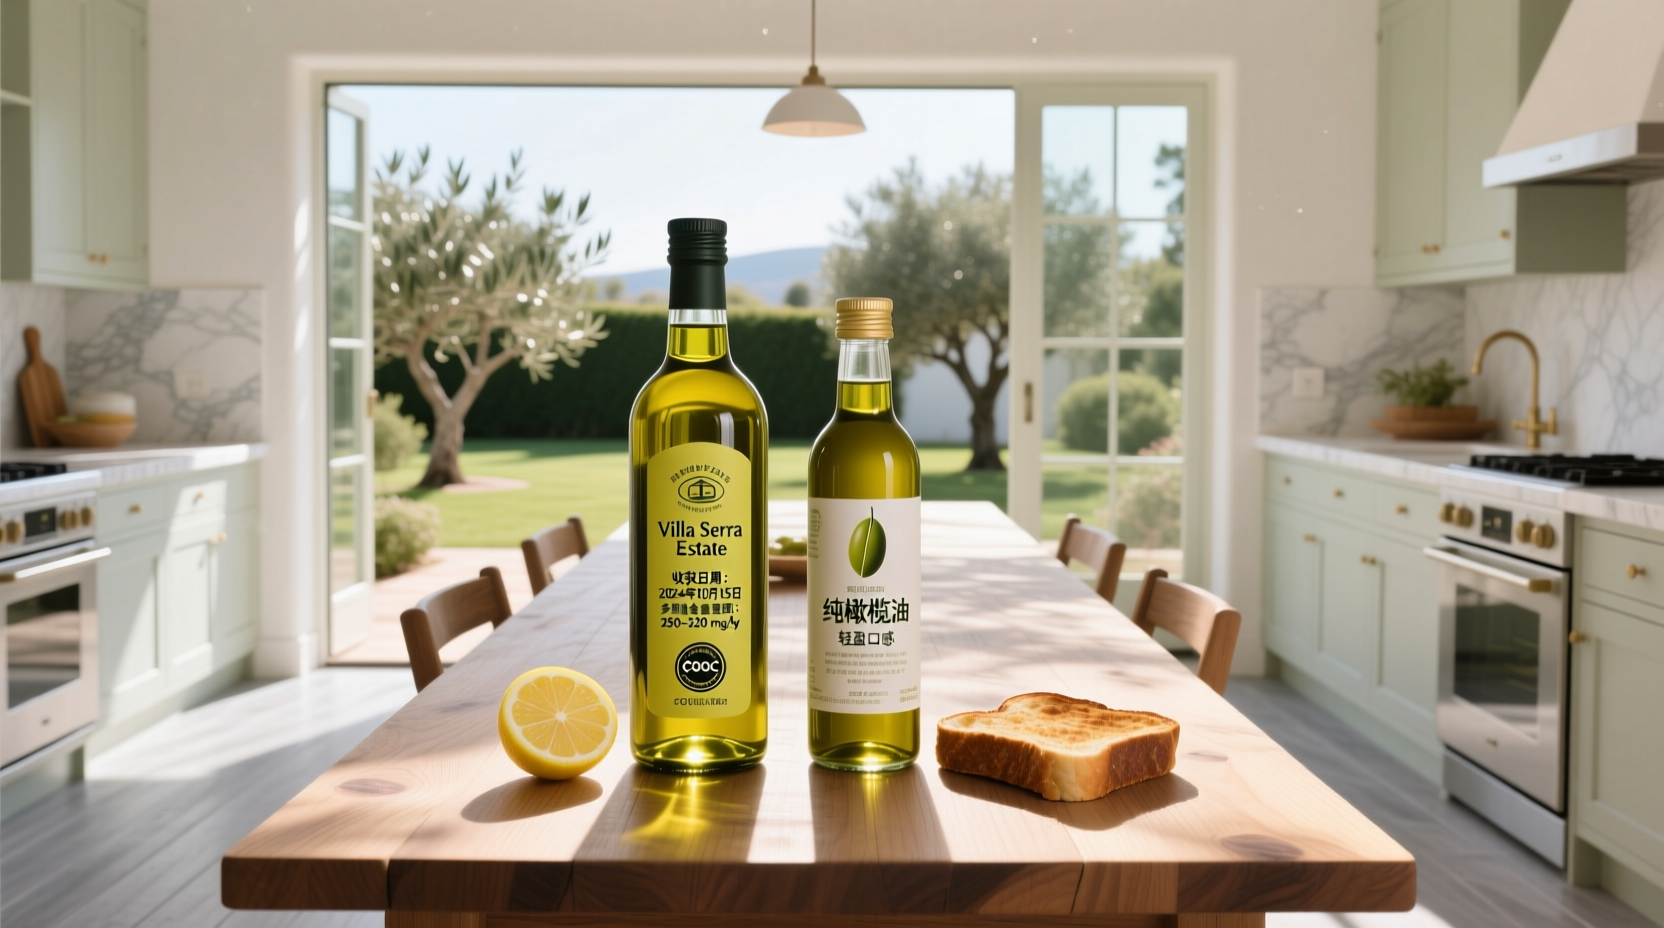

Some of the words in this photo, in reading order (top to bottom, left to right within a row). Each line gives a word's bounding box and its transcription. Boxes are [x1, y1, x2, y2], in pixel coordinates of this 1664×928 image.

[657, 520, 695, 538] Villa
[700, 521, 743, 538] Serra
[676, 540, 728, 556] Estate
[822, 597, 910, 624] 纯橄榄油
